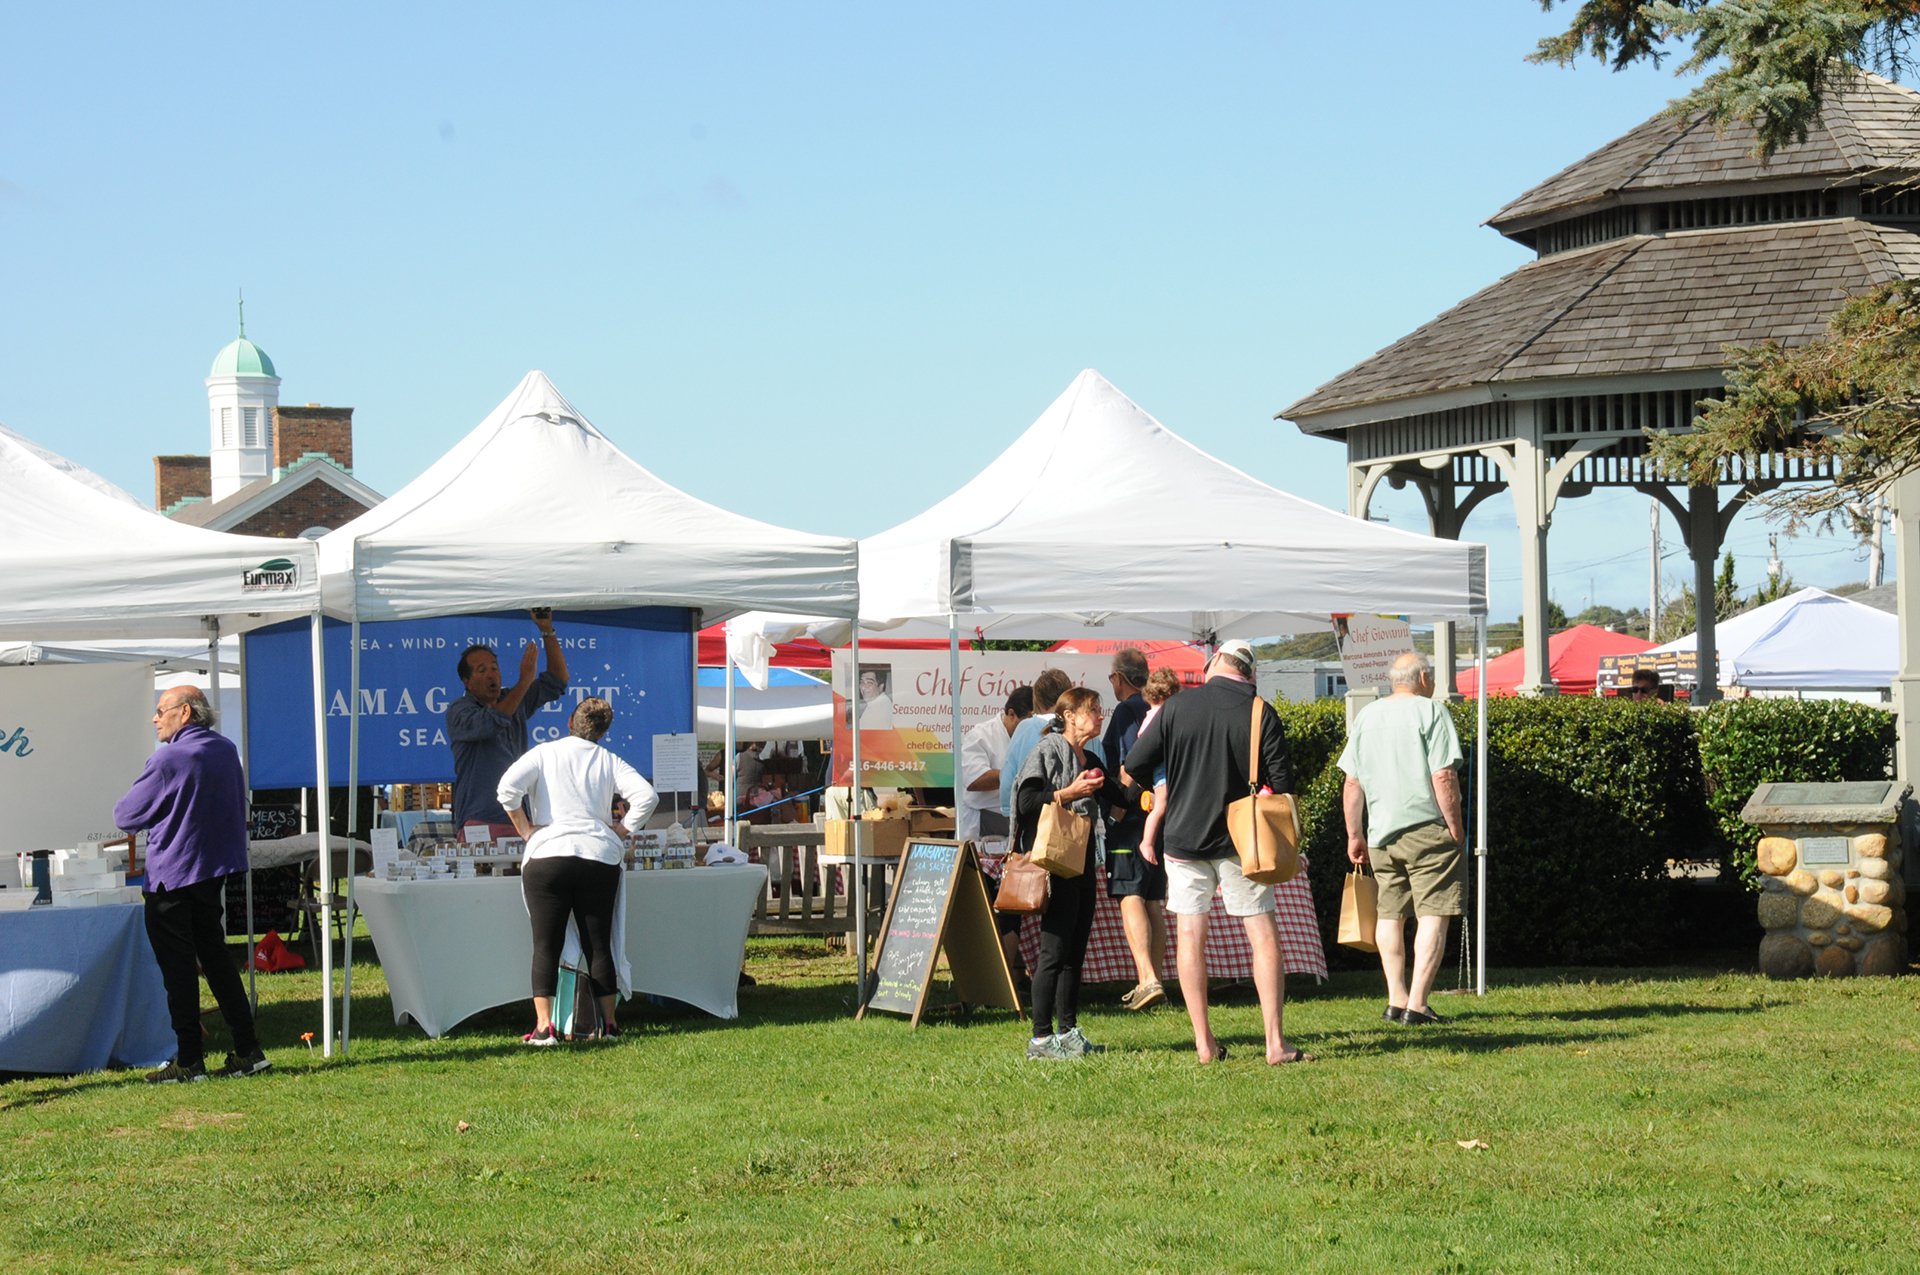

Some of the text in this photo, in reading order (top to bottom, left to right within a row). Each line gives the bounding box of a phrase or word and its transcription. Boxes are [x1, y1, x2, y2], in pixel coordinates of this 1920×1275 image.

[243, 570, 293, 586] Eurmax
[1351, 624, 1409, 645] Chef Giovanni
[401, 638, 456, 649] WIND
[466, 637, 498, 648] SUN
[519, 637, 597, 649] PTENCE
[1361, 672, 1391, 685] 516-446-
[892, 703, 936, 715] Seasoned
[938, 704, 979, 716] Maona
[399, 728, 447, 747] SEA
